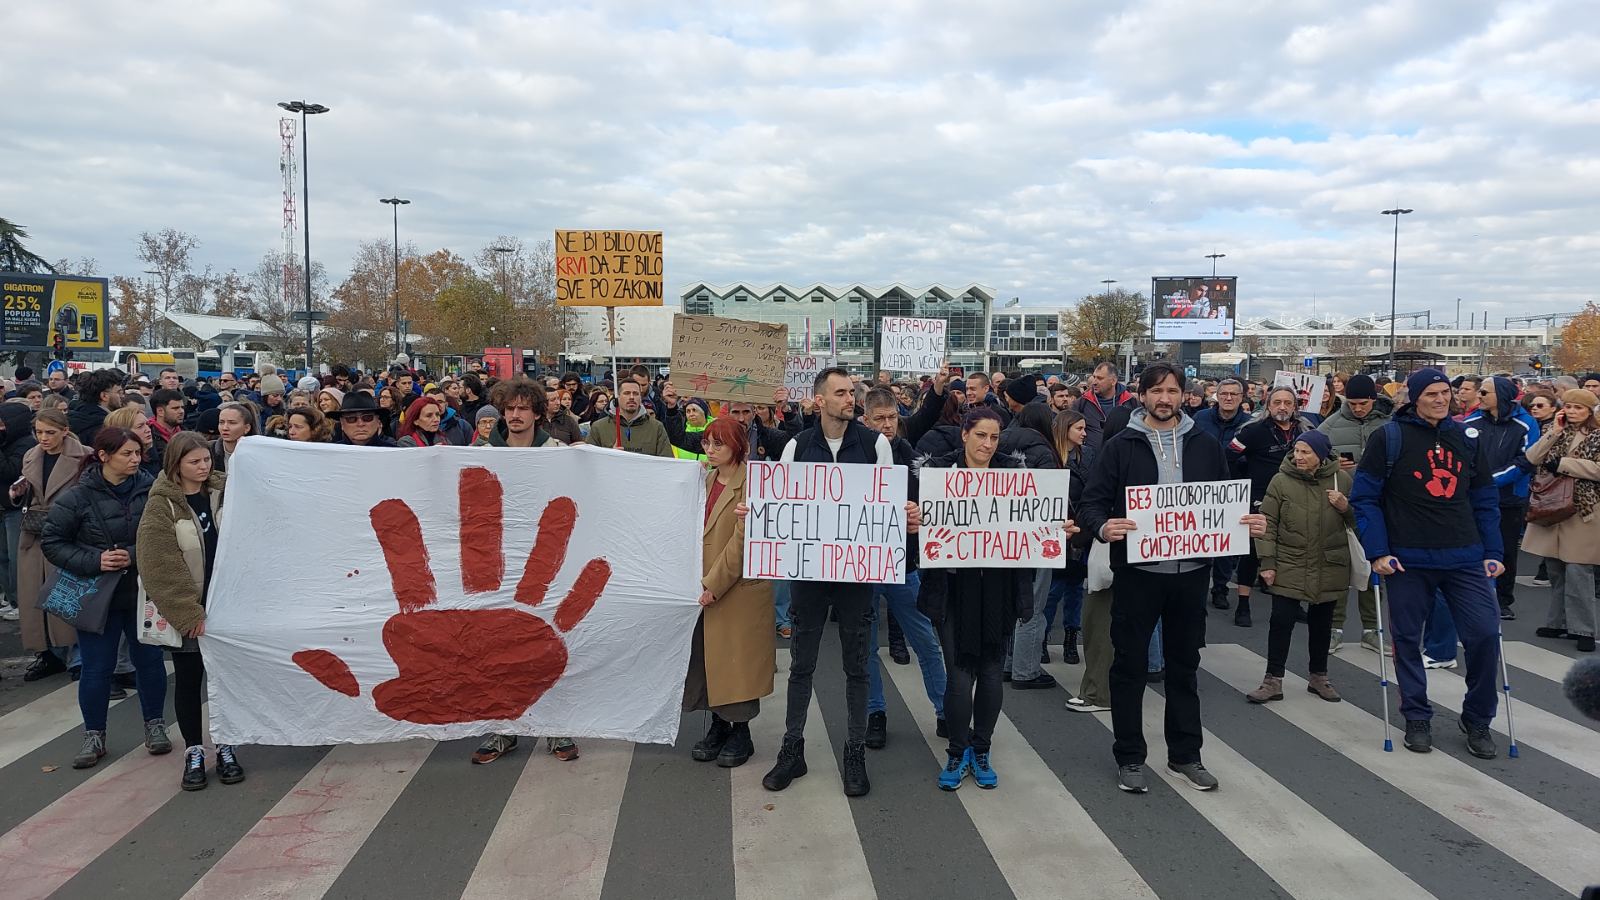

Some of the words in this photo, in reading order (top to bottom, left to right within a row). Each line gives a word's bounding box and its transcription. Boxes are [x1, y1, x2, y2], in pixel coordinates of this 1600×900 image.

[556, 231, 578, 253] NE
[583, 231, 597, 251] BI
[603, 231, 635, 252] BILO
[638, 232, 662, 254] OVE
[556, 255, 587, 276] KRVI
[590, 255, 610, 275] DA
[613, 255, 630, 274] JE
[634, 255, 663, 276] BILO
[3, 283, 44, 293] GIGATRON
[557, 278, 586, 301] SVE
[590, 278, 609, 299] PO
[613, 278, 663, 300] ZAKONU
[4, 295, 41, 311] 25%
[4, 310, 41, 318] POPUSTA
[676, 316, 704, 332] TO
[716, 322, 748, 334] SMO
[883, 318, 943, 334] NEPRAVDA
[678, 334, 706, 344] BITI
[760, 343, 782, 354] SMO
[886, 334, 924, 351] NIKAD
[929, 336, 944, 352] NE
[786, 356, 817, 370] RAVDA
[881, 353, 912, 369] VLADA
[748, 462, 844, 502] ПРОШЛО
[864, 467, 893, 503] ЈЕ
[945, 470, 1038, 498] КОРУПЦИЈА
[1127, 487, 1152, 510] БЕЗ
[1156, 483, 1249, 509] ОДГОВОРНОСТИ
[750, 502, 821, 541] МЕСЕЦ
[835, 504, 903, 543] ДАНА
[921, 498, 981, 527] ВЛАДА
[988, 497, 999, 523] А
[1009, 497, 1066, 523] НАРОД
[1155, 510, 1197, 534] НЕМА
[1202, 508, 1225, 530] НИ
[957, 531, 1031, 561] СТРАДА
[748, 541, 786, 577] ГДЕ
[788, 542, 814, 579] ЈЕ
[821, 544, 906, 583] ПРАВДА?
